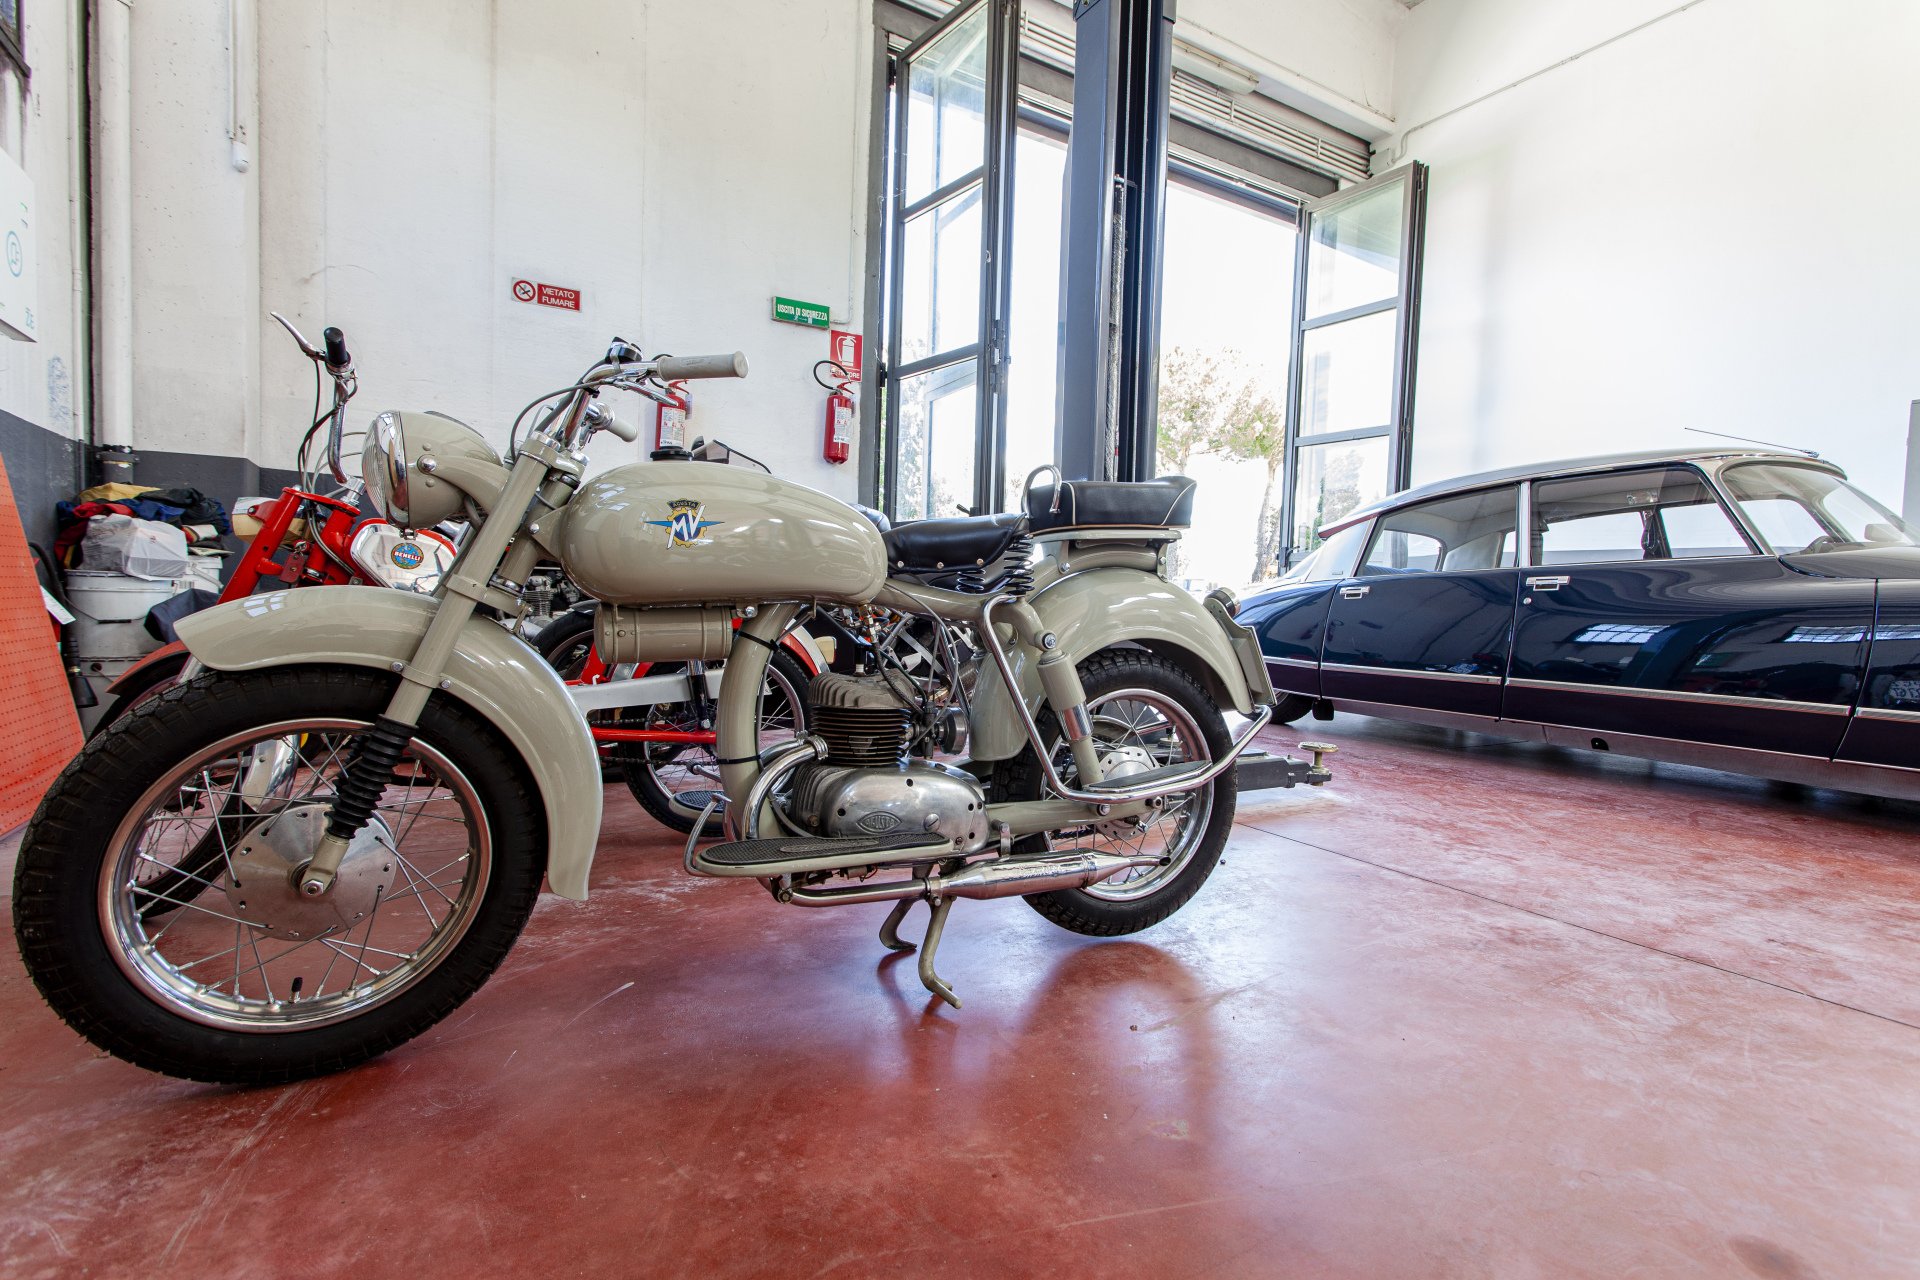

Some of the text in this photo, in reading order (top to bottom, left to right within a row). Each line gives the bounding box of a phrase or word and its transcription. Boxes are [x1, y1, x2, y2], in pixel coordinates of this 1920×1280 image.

[541, 286, 575, 299] VIETATO
[542, 295, 575, 309] FUMARE
[777, 303, 828, 321] USCITA DI SICUREZZA
[672, 500, 697, 508] AGUSTA
[666, 504, 706, 550] MV
[394, 551, 421, 561] BENELLI
